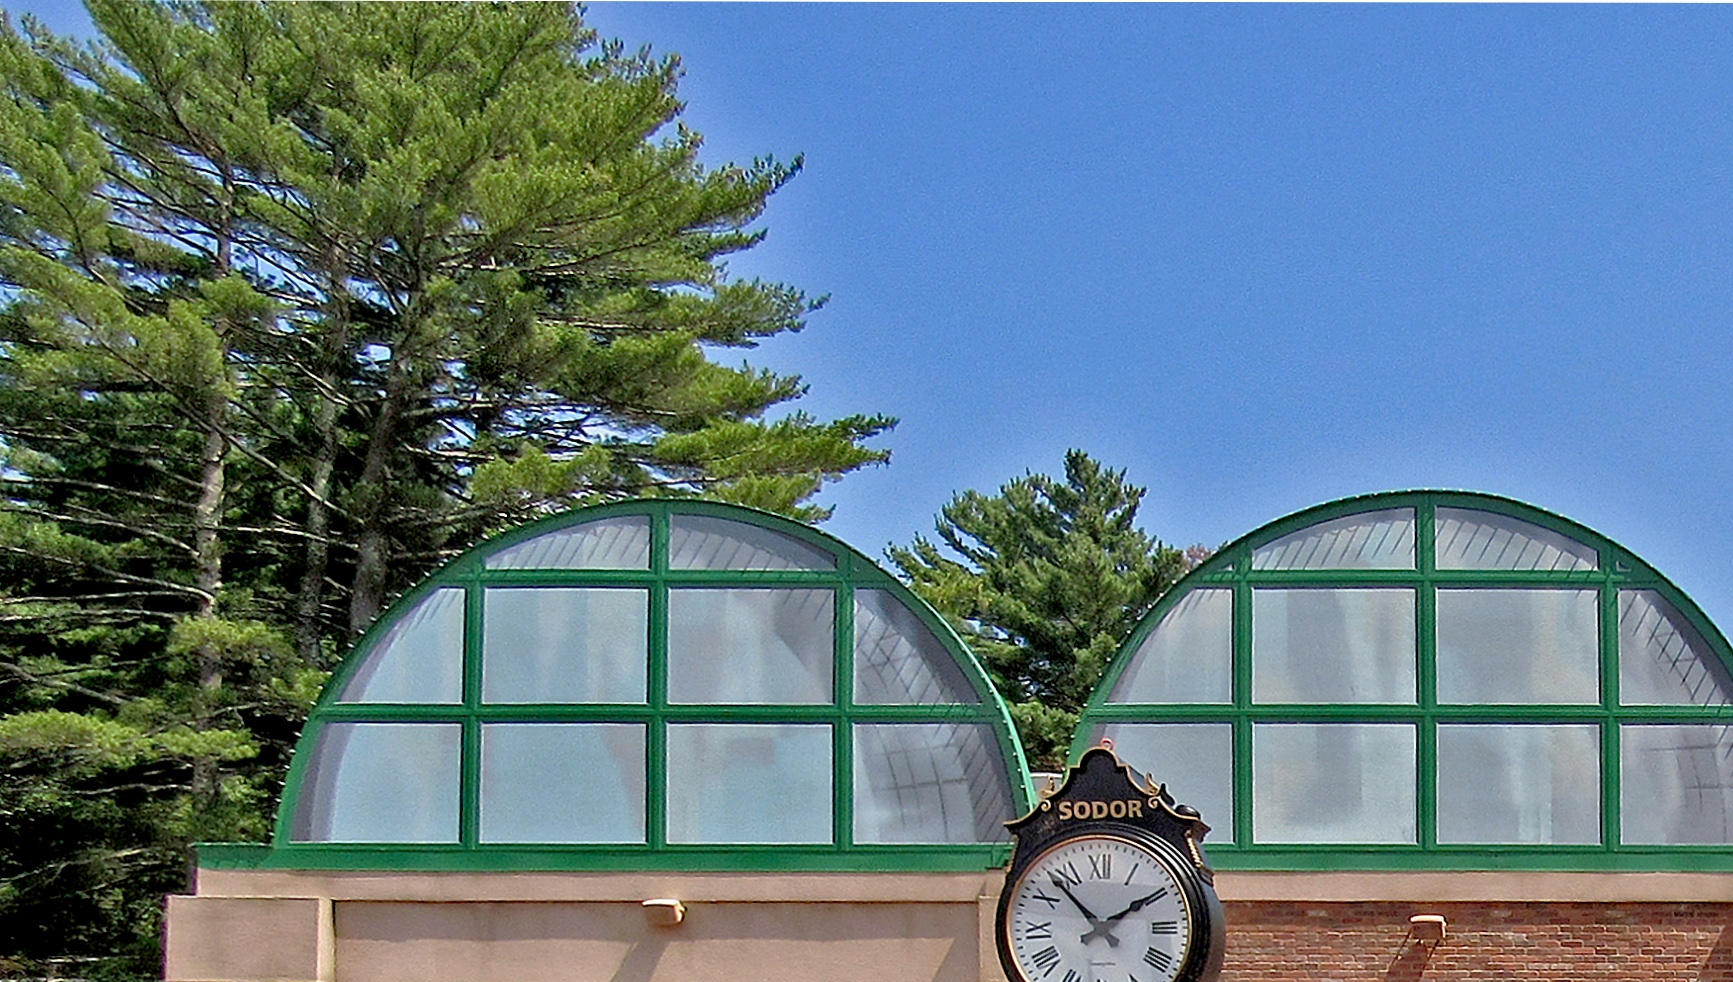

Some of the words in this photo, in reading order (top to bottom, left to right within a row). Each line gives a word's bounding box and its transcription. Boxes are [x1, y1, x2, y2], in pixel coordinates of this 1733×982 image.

[1058, 800, 1144, 820] SODOR
[1088, 854, 1111, 880] XII
[1032, 887, 1061, 910] X
[1025, 920, 1052, 940] IX
[1152, 921, 1178, 935] III
